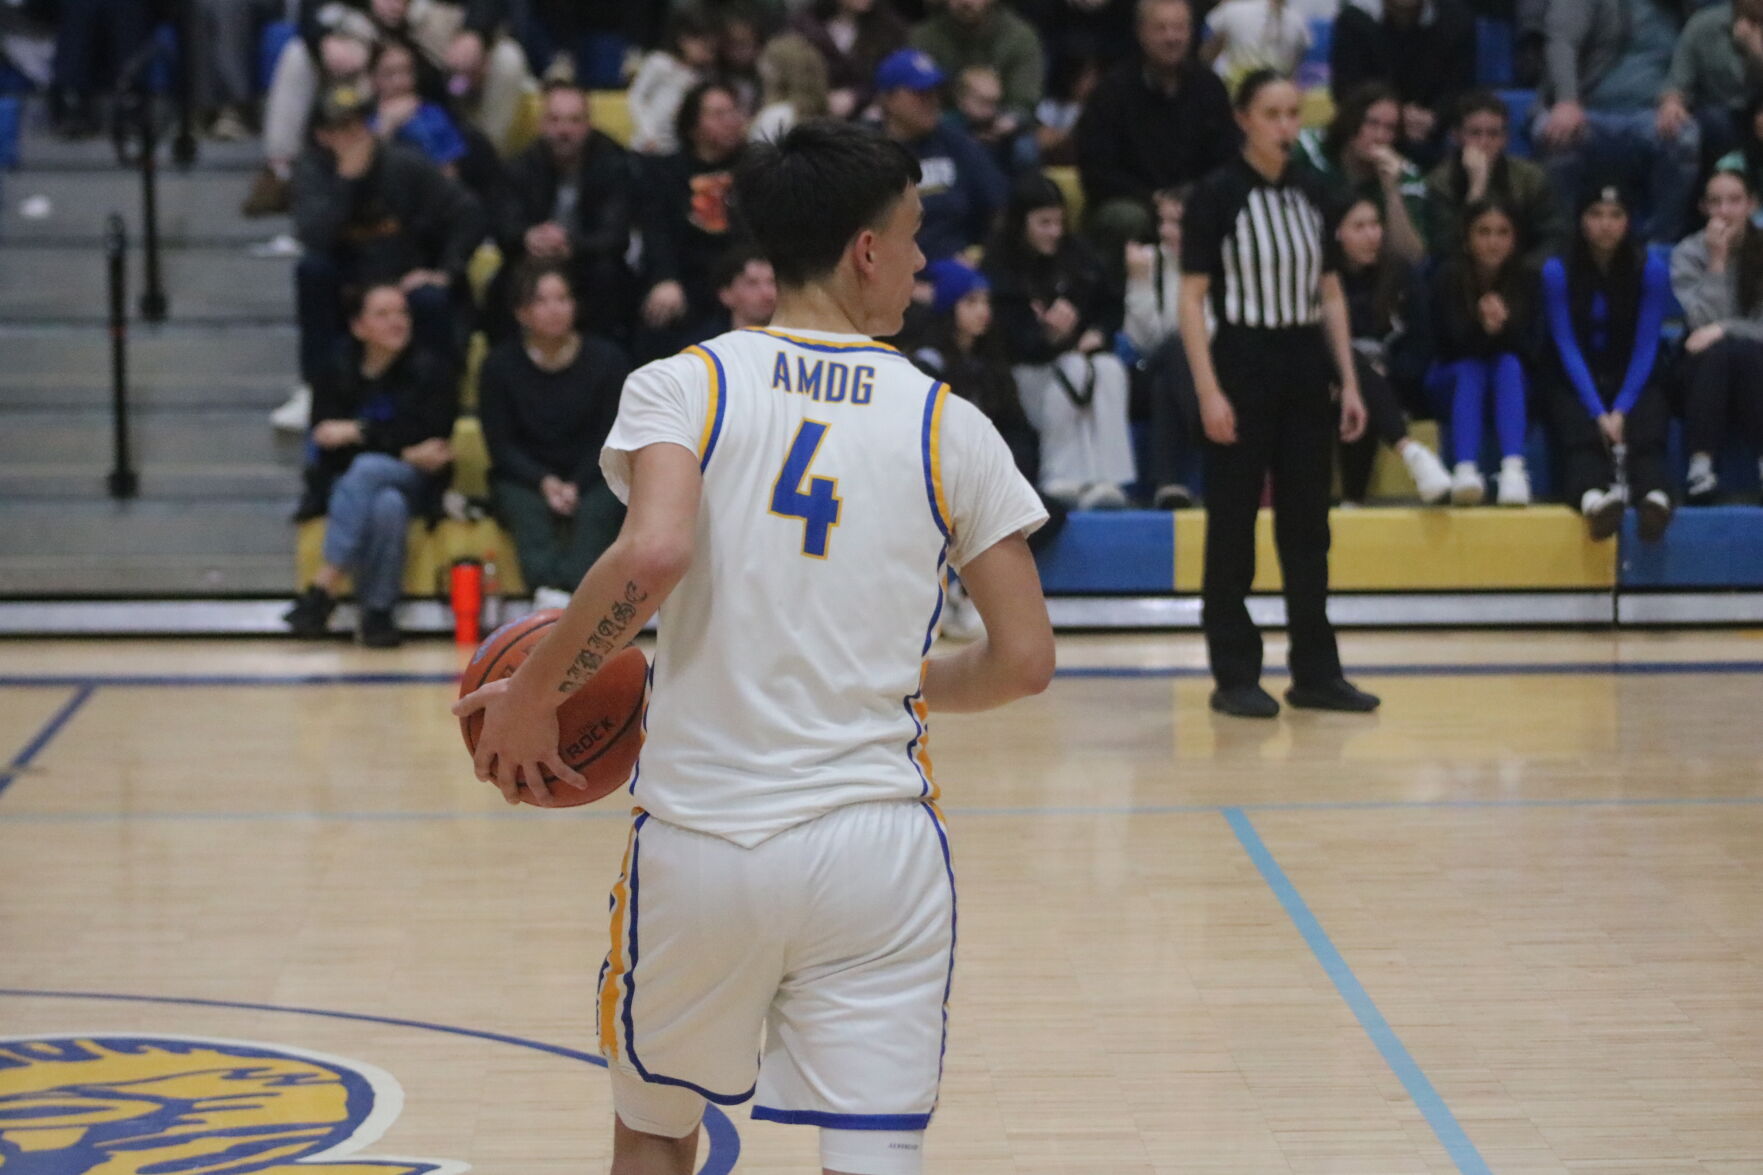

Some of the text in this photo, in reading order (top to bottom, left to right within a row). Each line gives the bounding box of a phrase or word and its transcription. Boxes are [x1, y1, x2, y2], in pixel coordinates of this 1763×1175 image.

[771, 350, 876, 405] AMDG
[767, 416, 844, 561] 4
[565, 715, 616, 760] ROCK
